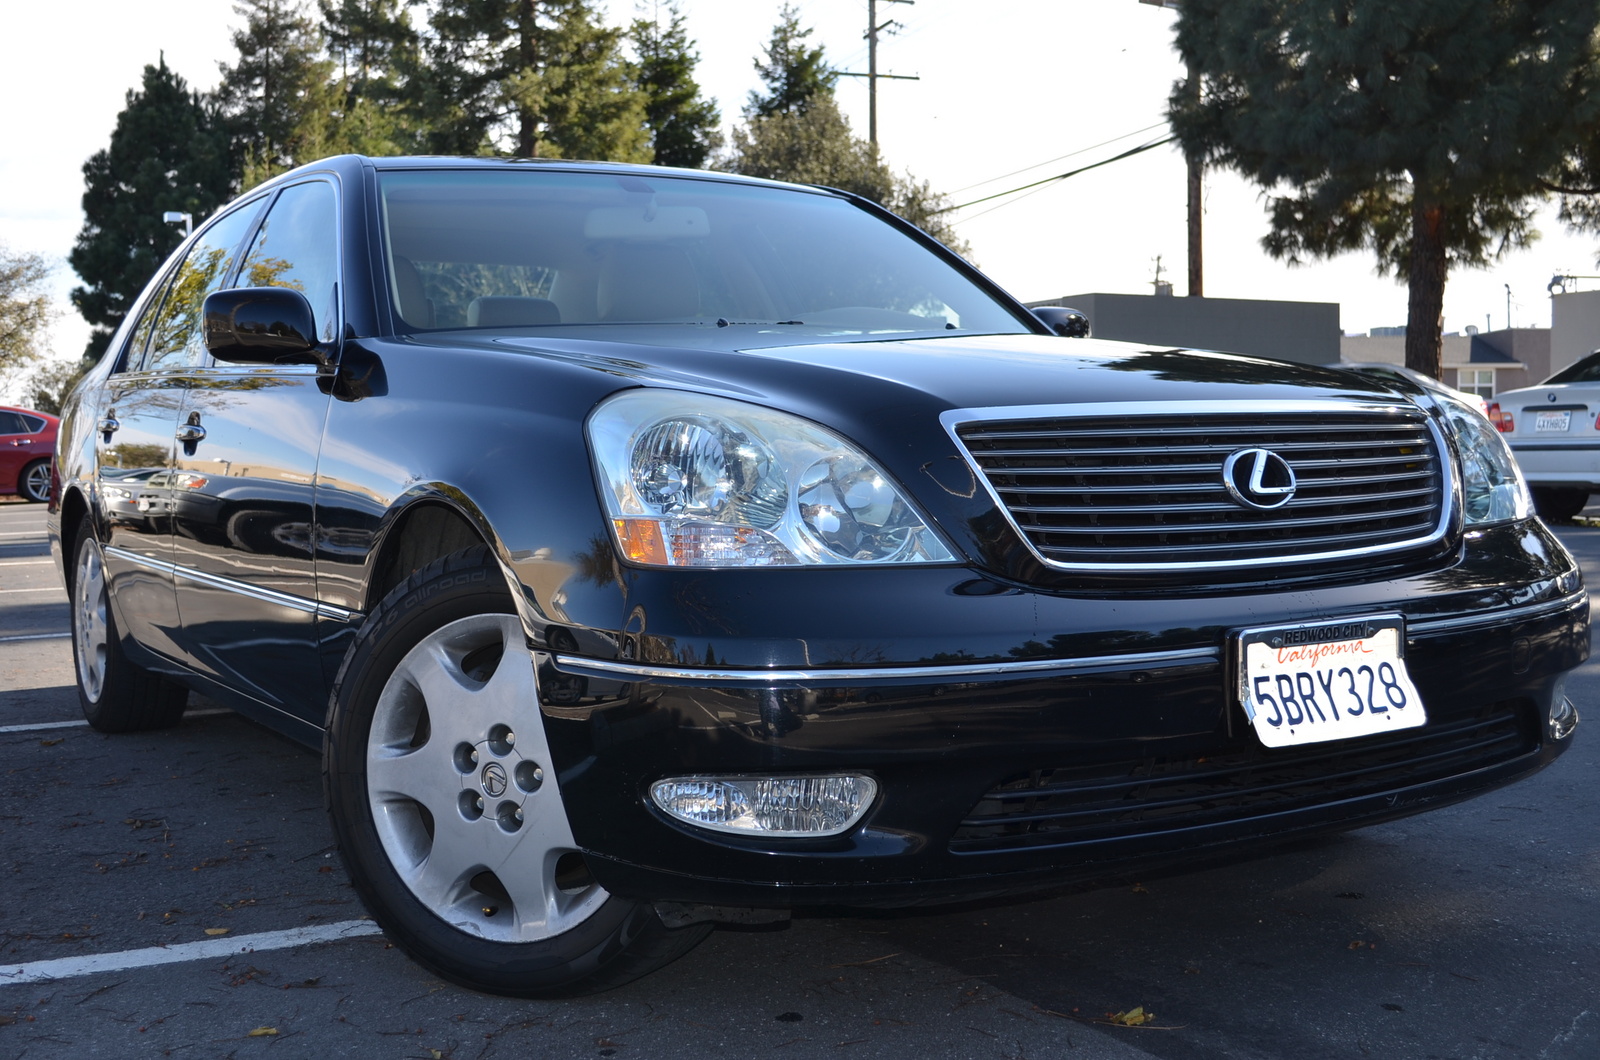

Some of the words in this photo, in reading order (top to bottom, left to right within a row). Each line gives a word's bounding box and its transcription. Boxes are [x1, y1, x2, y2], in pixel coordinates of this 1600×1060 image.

[404, 568, 487, 609] allroad
[1284, 626, 1340, 644] REDWOOD
[1342, 623, 1366, 638] CITY
[1277, 640, 1374, 668] California
[1253, 661, 1407, 727] 5BRY328
